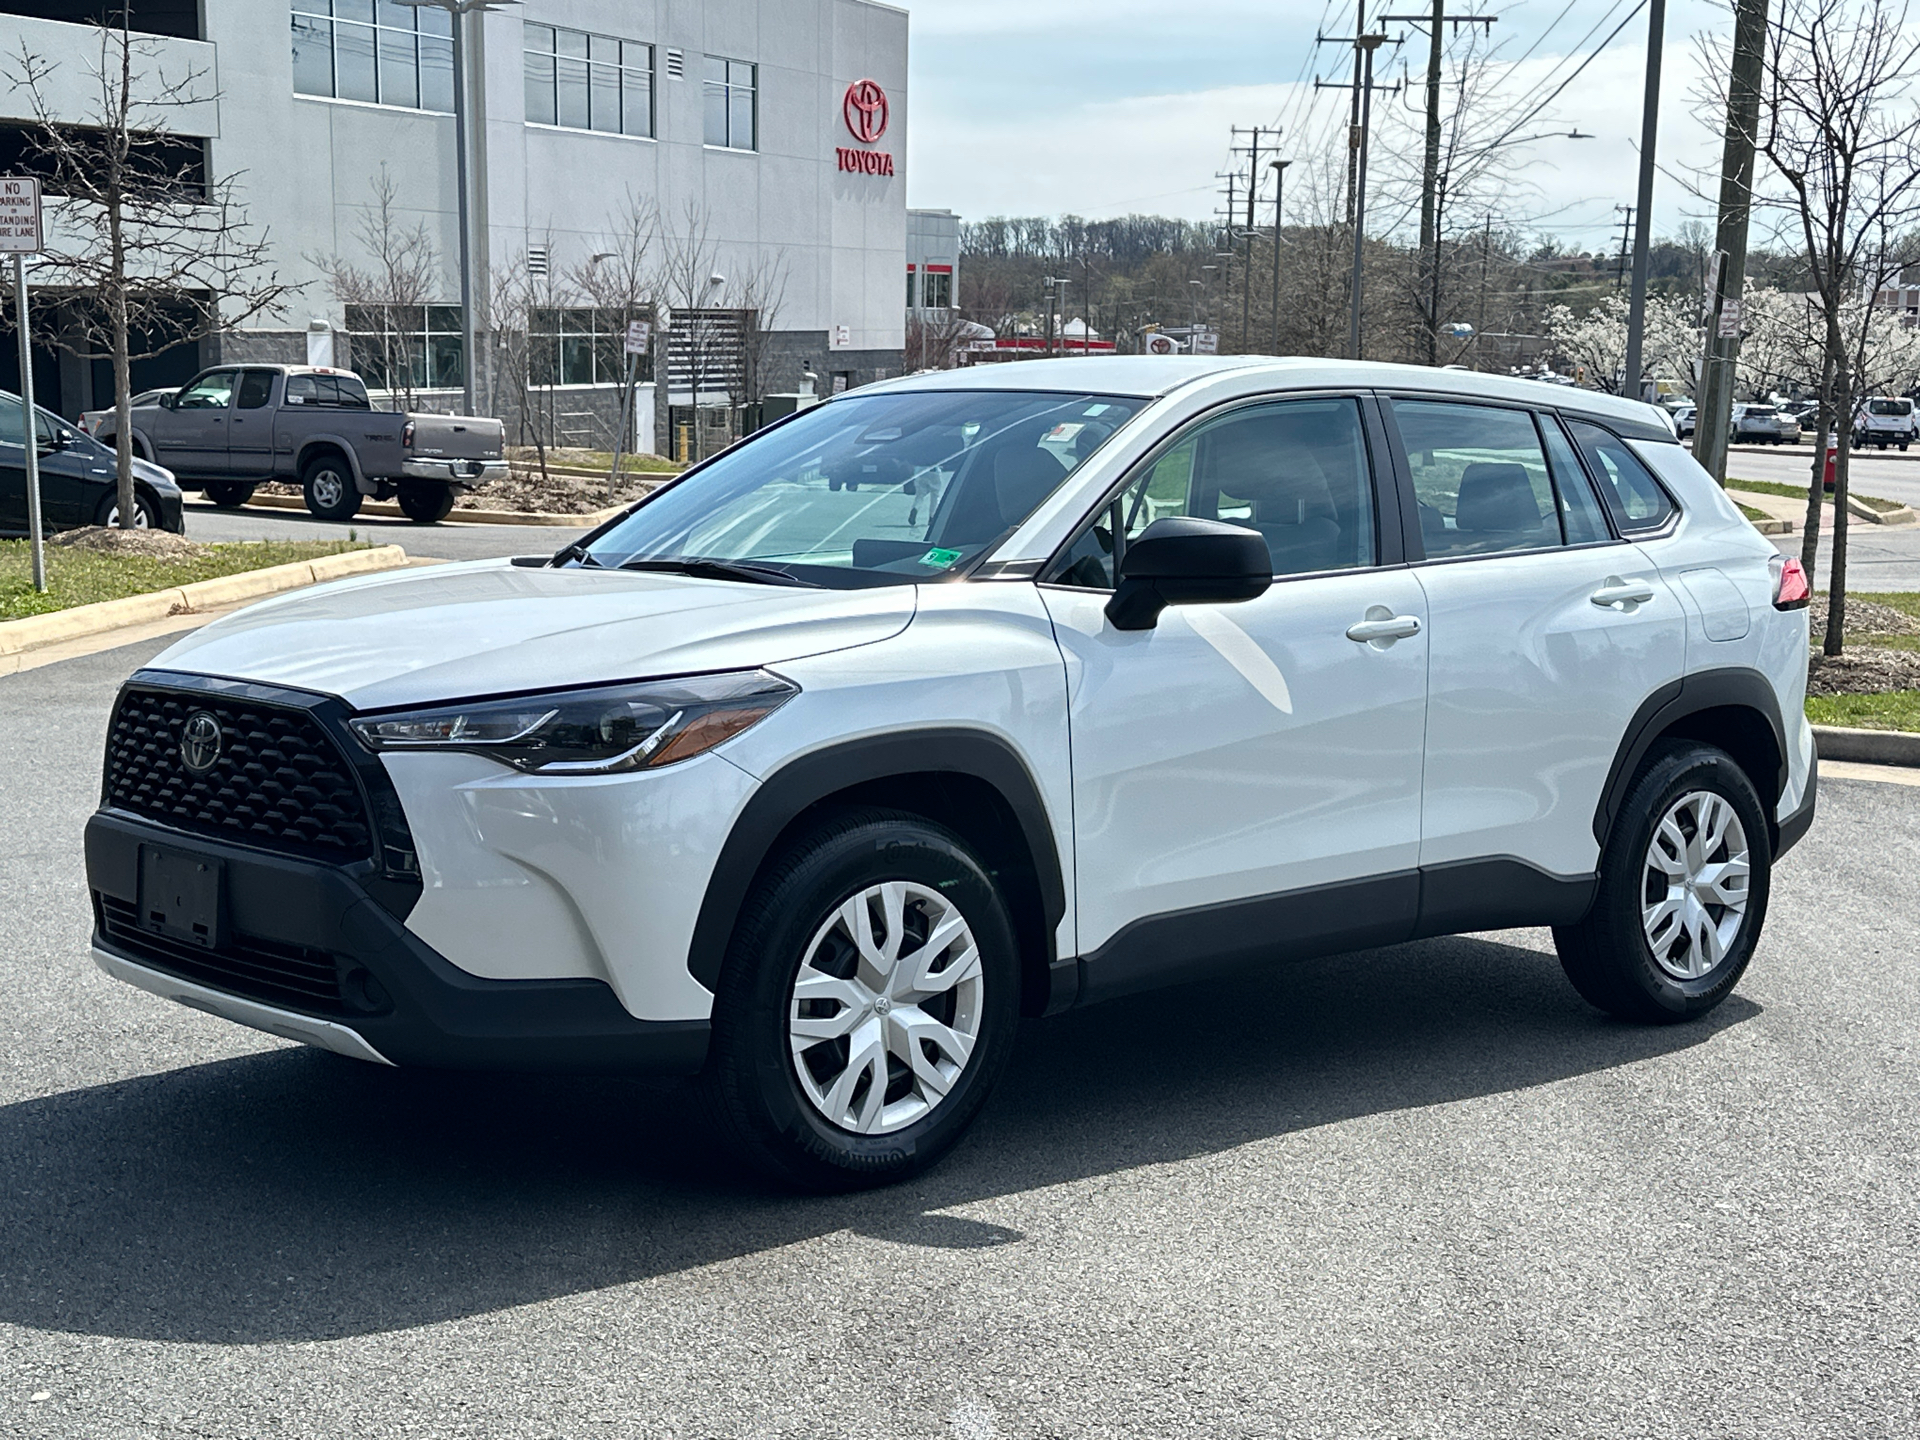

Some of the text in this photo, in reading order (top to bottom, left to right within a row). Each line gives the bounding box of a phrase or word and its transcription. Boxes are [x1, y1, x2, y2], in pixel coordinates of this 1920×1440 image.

[836, 147, 894, 177] TOYOTA
[5, 182, 20, 195] NO
[0, 215, 35, 226] TANDING
[0, 227, 35, 237] IRE LANE
